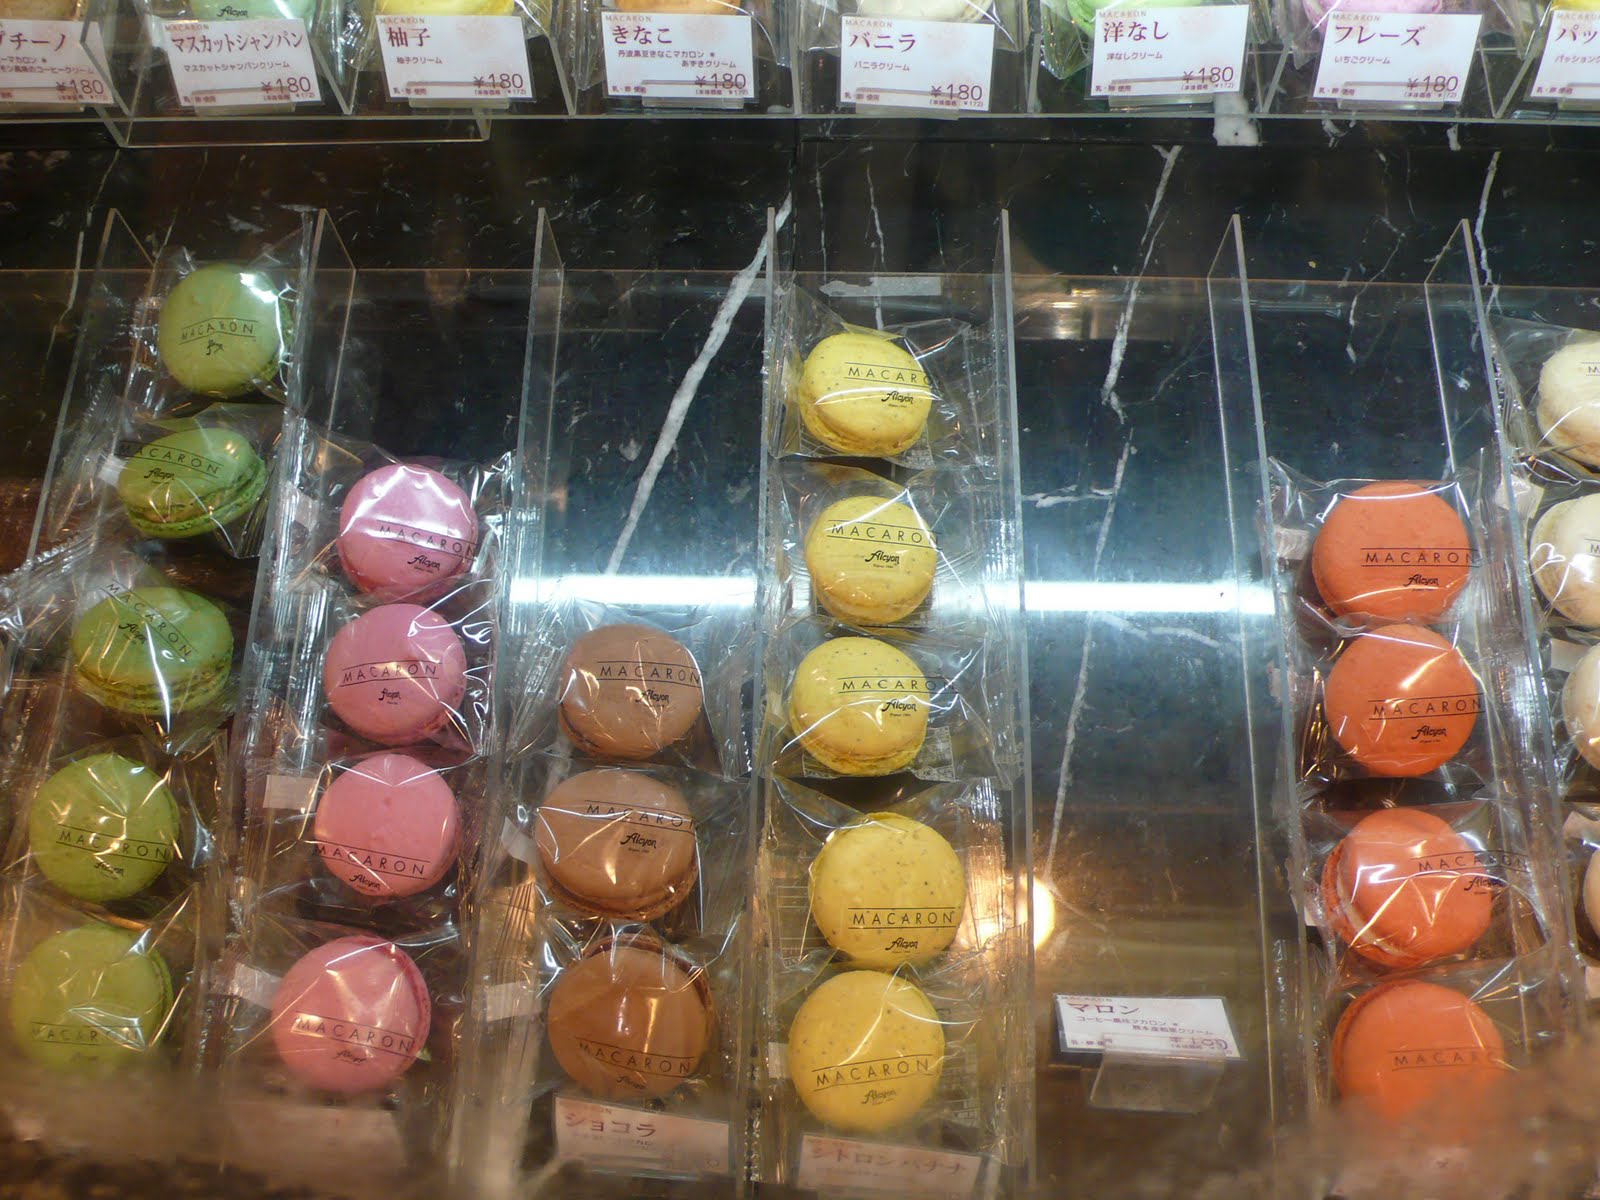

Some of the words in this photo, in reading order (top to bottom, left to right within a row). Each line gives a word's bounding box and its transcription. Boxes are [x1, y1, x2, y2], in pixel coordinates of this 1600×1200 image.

[1099, 10, 1147, 18] MACARON
[1332, 14, 1381, 22] MACARON
[845, 20, 893, 28] MACARON
[1103, 21, 1169, 43] 洋なし
[171, 30, 304, 53] マスカットシャンパン
[386, 26, 431, 48] 柚子
[612, 25, 673, 45] きなこ
[849, 31, 917, 53] バニラ
[1335, 25, 1426, 47] フレーズ
[1555, 24, 1598, 44] パッ
[1106, 51, 1163, 61] 洋なしクリーム
[1334, 55, 1391, 65] いちごクリーム
[854, 61, 910, 71] バニラクリーム
[1183, 66, 1234, 84] ¥180
[56, 79, 104, 95] ¥180
[261, 76, 311, 93] ¥180
[473, 73, 524, 89] ¥180
[695, 73, 747, 90] ¥180
[1406, 75, 1459, 93] ¥180
[931, 83, 983, 101] ¥180
[181, 321, 254, 340] MACARON
[881, 390, 914, 404] Alcyon
[120, 443, 222, 474] ACARON
[380, 525, 476, 557] MACARON
[407, 554, 441, 571] Alcyon
[865, 550, 899, 564] Alcyon
[1365, 552, 1476, 564] MACARON
[1403, 573, 1440, 587] Alcyon
[106, 583, 192, 657] MACARON
[343, 663, 436, 683] MACARON
[600, 665, 700, 684] MACARON
[635, 689, 670, 703] Alcyon
[881, 698, 917, 712] Alcyon
[1373, 698, 1481, 717] MACARON
[1411, 725, 1448, 740] Alcyon
[59, 830, 168, 860] MACRON
[620, 832, 657, 849] Alcyon
[313, 845, 425, 875] MACARON
[852, 912, 953, 925] MACARON
[885, 937, 919, 951] Alcyon
[1067, 1003, 1140, 1015] マロン
[298, 1019, 411, 1053] MACARON
[579, 1042, 691, 1074] MACARON
[816, 1058, 929, 1087] MACARON
[565, 1113, 656, 1138] ショコラ
